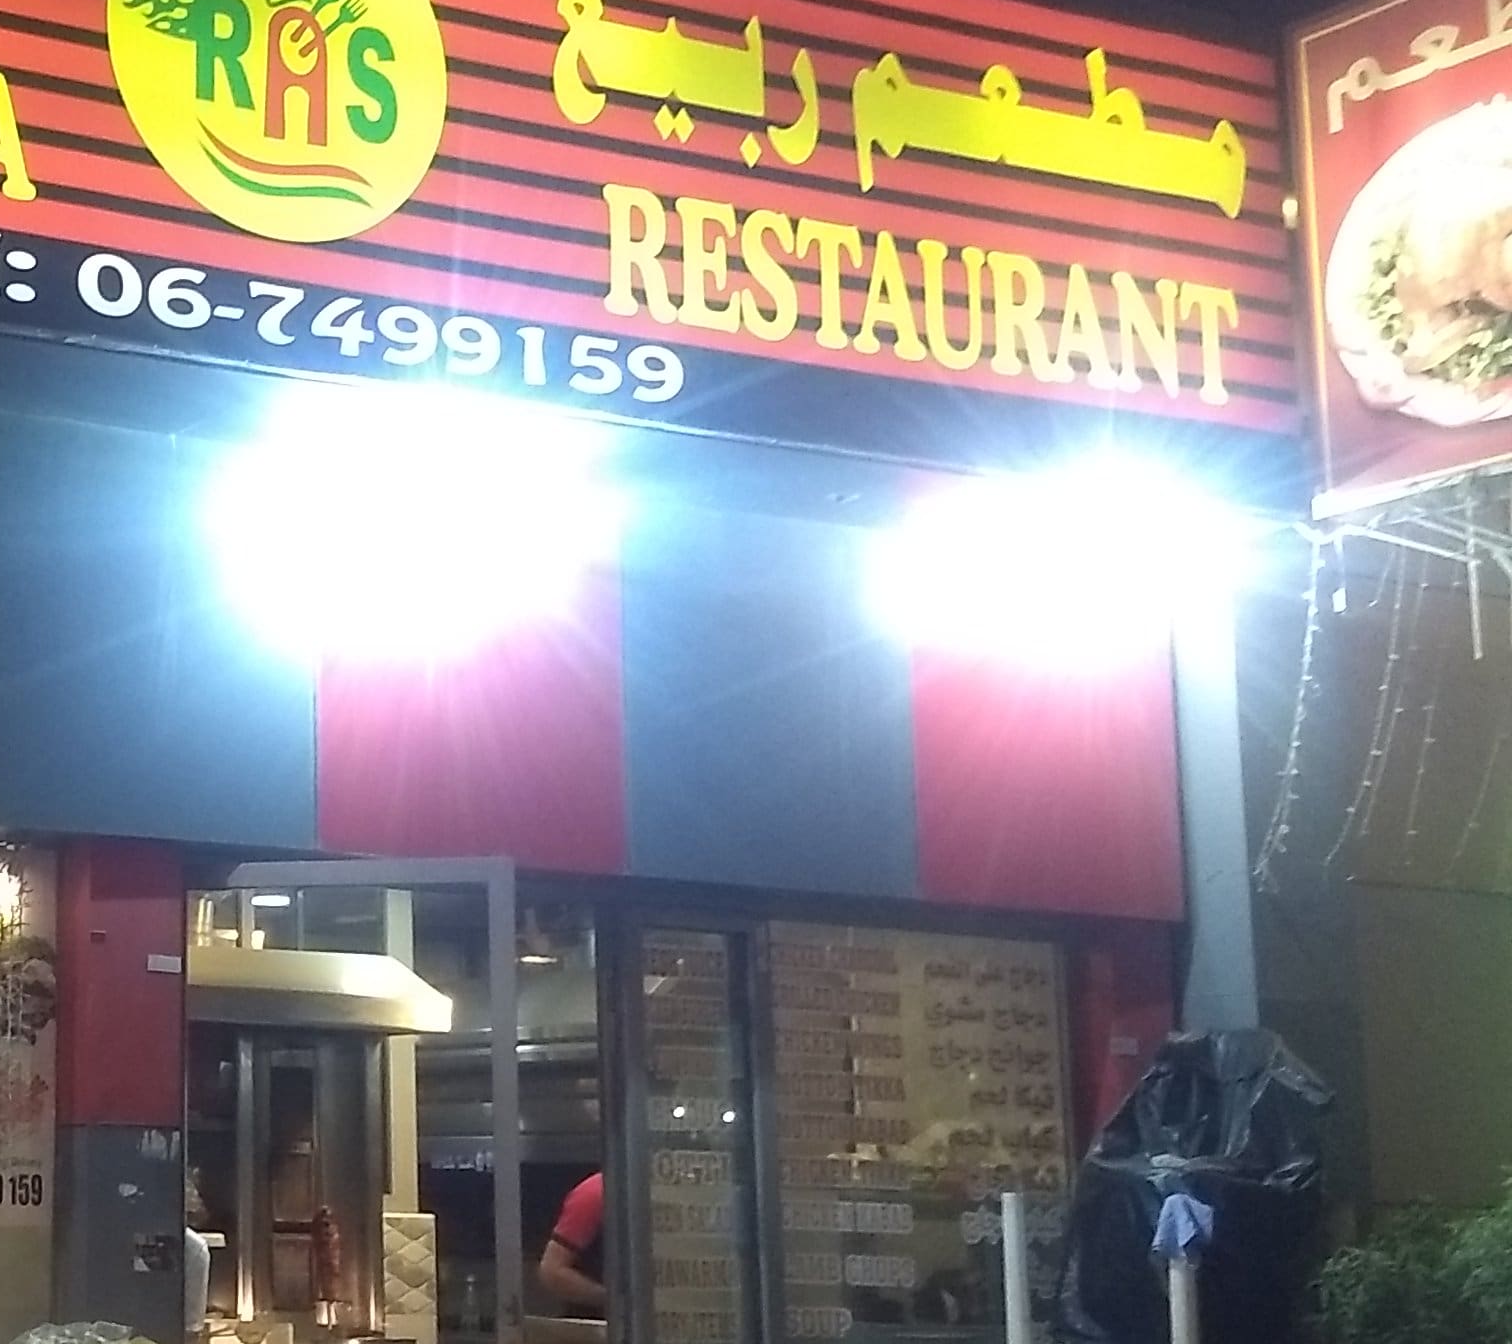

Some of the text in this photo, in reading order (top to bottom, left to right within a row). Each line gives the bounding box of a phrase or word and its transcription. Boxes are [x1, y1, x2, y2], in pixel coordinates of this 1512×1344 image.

[852, 48, 1247, 219] مطعم
[76, 253, 686, 405] 06-7499159
[602, 183, 1240, 406] RESTAURANT
